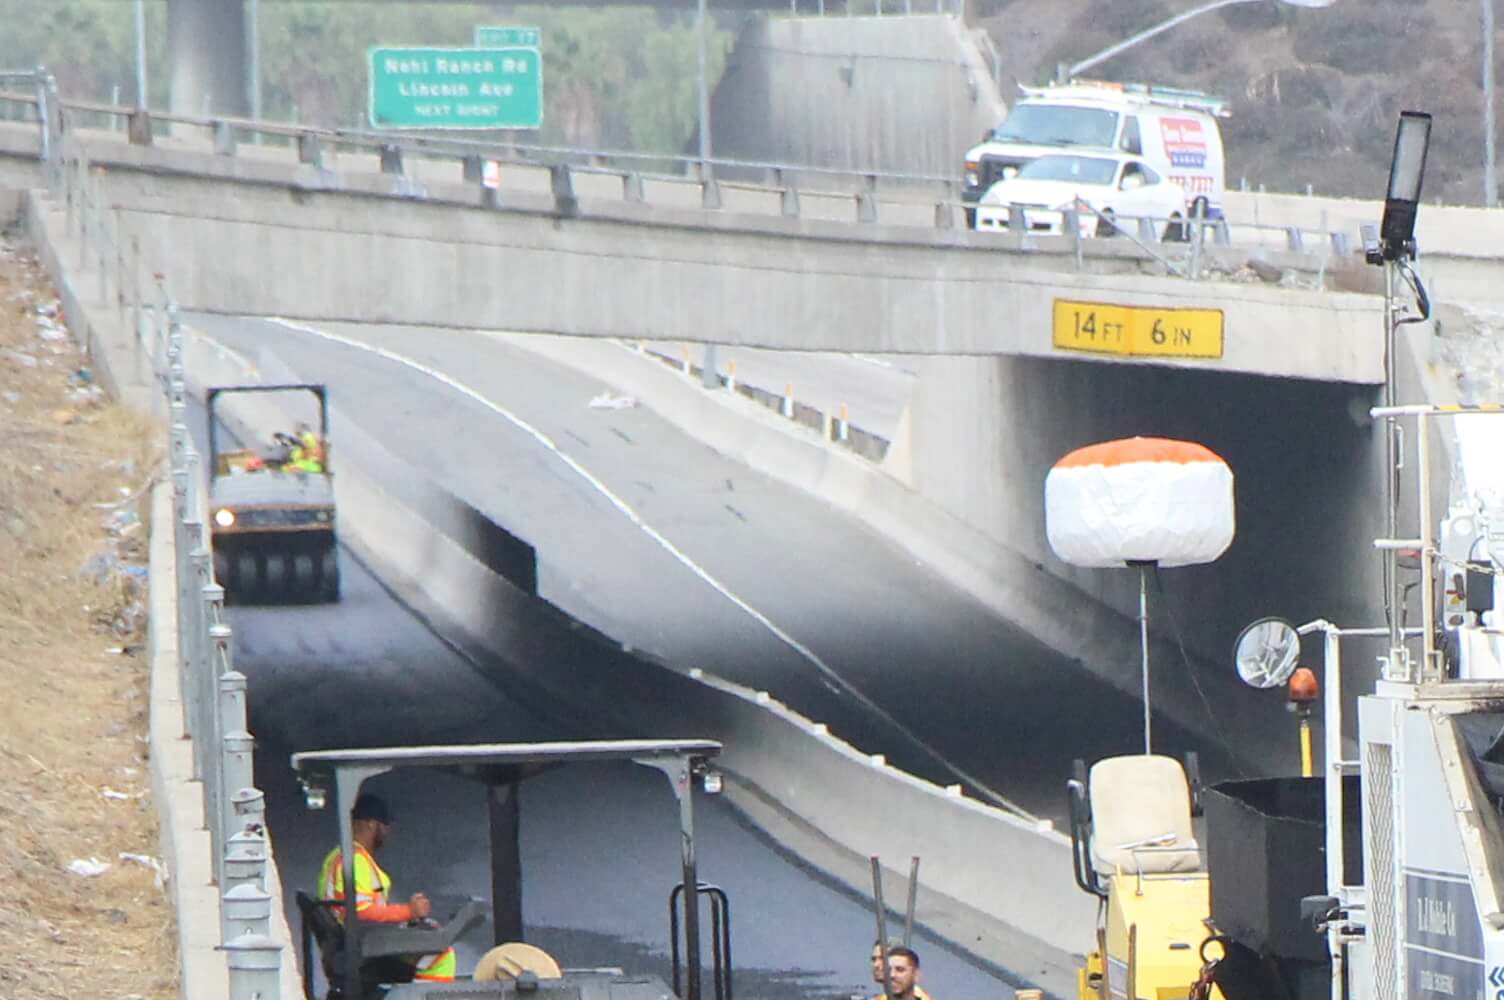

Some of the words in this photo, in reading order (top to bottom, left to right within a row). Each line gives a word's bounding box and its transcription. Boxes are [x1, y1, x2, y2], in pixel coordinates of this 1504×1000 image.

[436, 57, 496, 74] Ranch
[502, 57, 528, 74] Rd
[399, 82, 469, 97] Lincoln
[1074, 311, 1096, 341] 14
[1103, 323, 1123, 342] FT
[1152, 319, 1166, 345] 6
[1174, 327, 1191, 346] IN
